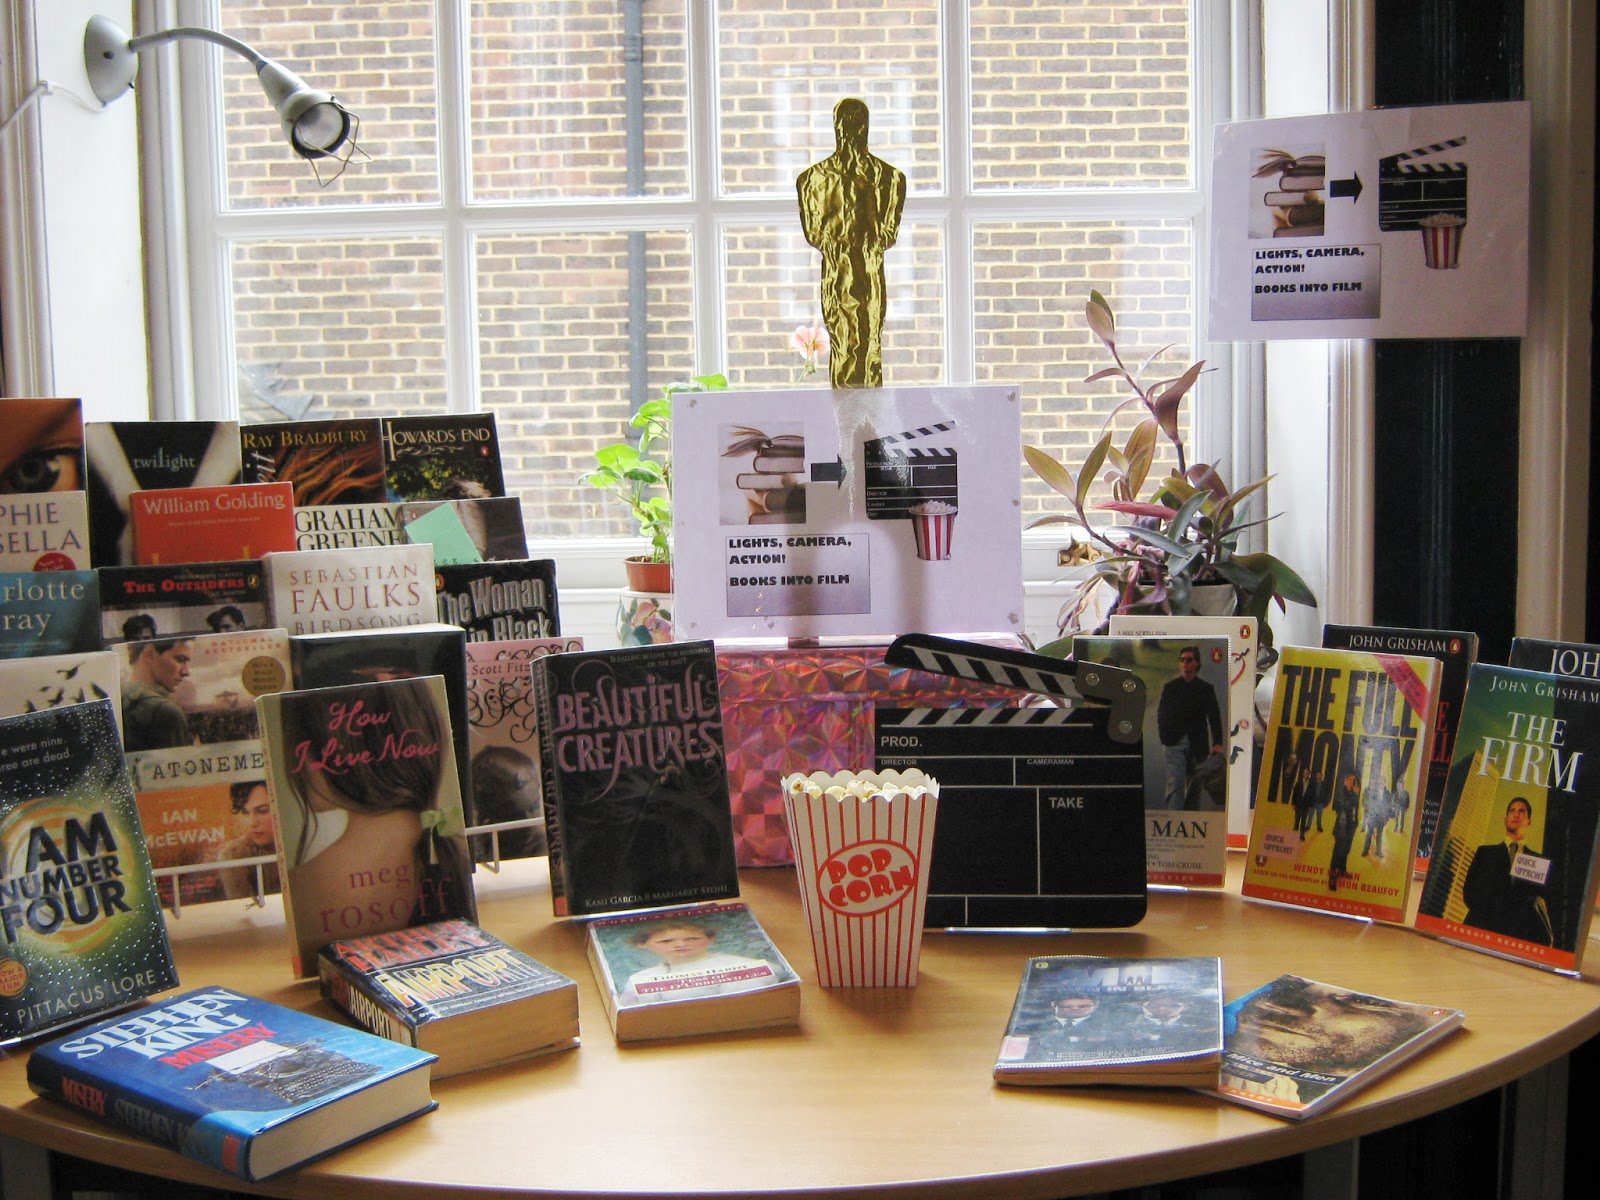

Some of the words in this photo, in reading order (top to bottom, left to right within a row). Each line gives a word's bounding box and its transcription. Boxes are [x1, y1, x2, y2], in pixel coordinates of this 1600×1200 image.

[1255, 249, 1303, 260] LIGHTS,
[1306, 247, 1365, 258] CAMERA,
[1255, 264, 1306, 274] ACTION!
[1254, 284, 1297, 294] BOOKS
[1299, 283, 1329, 293] INTO
[1332, 282, 1362, 292] FILM
[243, 433, 275, 449] RAY
[281, 429, 369, 446] BRADBURY
[382, 421, 456, 462] HOWARDS
[461, 428, 491, 442] END
[133, 447, 196, 472] twilight
[0, 502, 60, 526] PHIE
[143, 497, 210, 515] William
[216, 492, 286, 511] Golding
[295, 507, 399, 533] GRAHAM
[728, 537, 783, 549] LIGHTS,
[786, 536, 852, 548] CAMERA,
[729, 554, 787, 565] ACTION!
[161, 578, 246, 593] OUTSIDERS
[290, 563, 418, 586] SEBASTIAN
[729, 575, 778, 587] BOOKS
[781, 575, 814, 586] INTO
[817, 574, 850, 585] FILM
[3, 578, 85, 602] rlotte
[291, 582, 421, 615] FAULKS
[468, 576, 548, 620] Woman
[3, 613, 53, 637] ray
[295, 612, 421, 635] BIRDSONG
[492, 612, 552, 641] Black
[1349, 634, 1384, 649] JOHN
[1387, 636, 1447, 652] GRISHAM
[472, 663, 503, 676] Scott
[506, 662, 532, 674] Fitz
[1550, 648, 1600, 678] JOH
[553, 668, 717, 734] BEAUTIFUL
[1280, 664, 1342, 731] THE
[1343, 669, 1418, 739] FULL
[1489, 675, 1529, 693] JOHN
[1535, 681, 1600, 703] GRISHAM
[328, 700, 391, 736] How
[1507, 711, 1567, 746] THE
[11, 743, 38, 754] were
[310, 737, 375, 775] Live
[376, 728, 440, 762] Now
[557, 721, 723, 783] CREATURES
[880, 736, 923, 748] PROD.
[0, 762, 19, 771] ree
[22, 758, 40, 768] are
[153, 753, 265, 780] ATONEME
[881, 758, 917, 766] DIRECTOR
[1027, 758, 1075, 766] CAMERAMAN
[1267, 725, 1416, 812] MONTY
[1475, 735, 1584, 794] FIRM
[1049, 797, 1084, 809] TAKE
[162, 808, 198, 825] IAN
[1152, 820, 1208, 839] MAN
[25, 811, 118, 874] AM
[350, 864, 412, 889] meg
[826, 847, 893, 884] POP
[1176, 862, 1203, 870] CRUISE
[1293, 863, 1325, 876] WENDY
[1326, 868, 1361, 882] HODEN
[0, 855, 123, 906] NUMBER
[828, 864, 914, 907] CORN
[1360, 883, 1400, 897] BEAUFOY
[319, 875, 453, 933] rosoff
[585, 898, 608, 908] KAMI
[610, 894, 643, 905] GARCIA
[651, 887, 699, 900] MARGARET
[700, 885, 729, 894] STOHL
[0, 879, 133, 945] FOUR
[1446, 923, 1491, 941] PENGUIN
[1496, 937, 1545, 956] READERS
[0, 967, 16, 977] OW
[374, 948, 542, 1009] AIRPORT
[650, 968, 700, 982] THOMAS
[706, 964, 749, 976] HARDY
[17, 985, 105, 1024] PITTACUS
[111, 970, 157, 995] LORE
[641, 985, 668, 994] THE
[58, 988, 249, 1061] STEPHEN
[350, 984, 392, 1040] AIRPORT
[117, 1007, 251, 1061] KING
[158, 1021, 279, 1070] MISERY
[1226, 1053, 1264, 1067] Mice
[1266, 1064, 1300, 1076] and
[1300, 1072, 1337, 1082] Men
